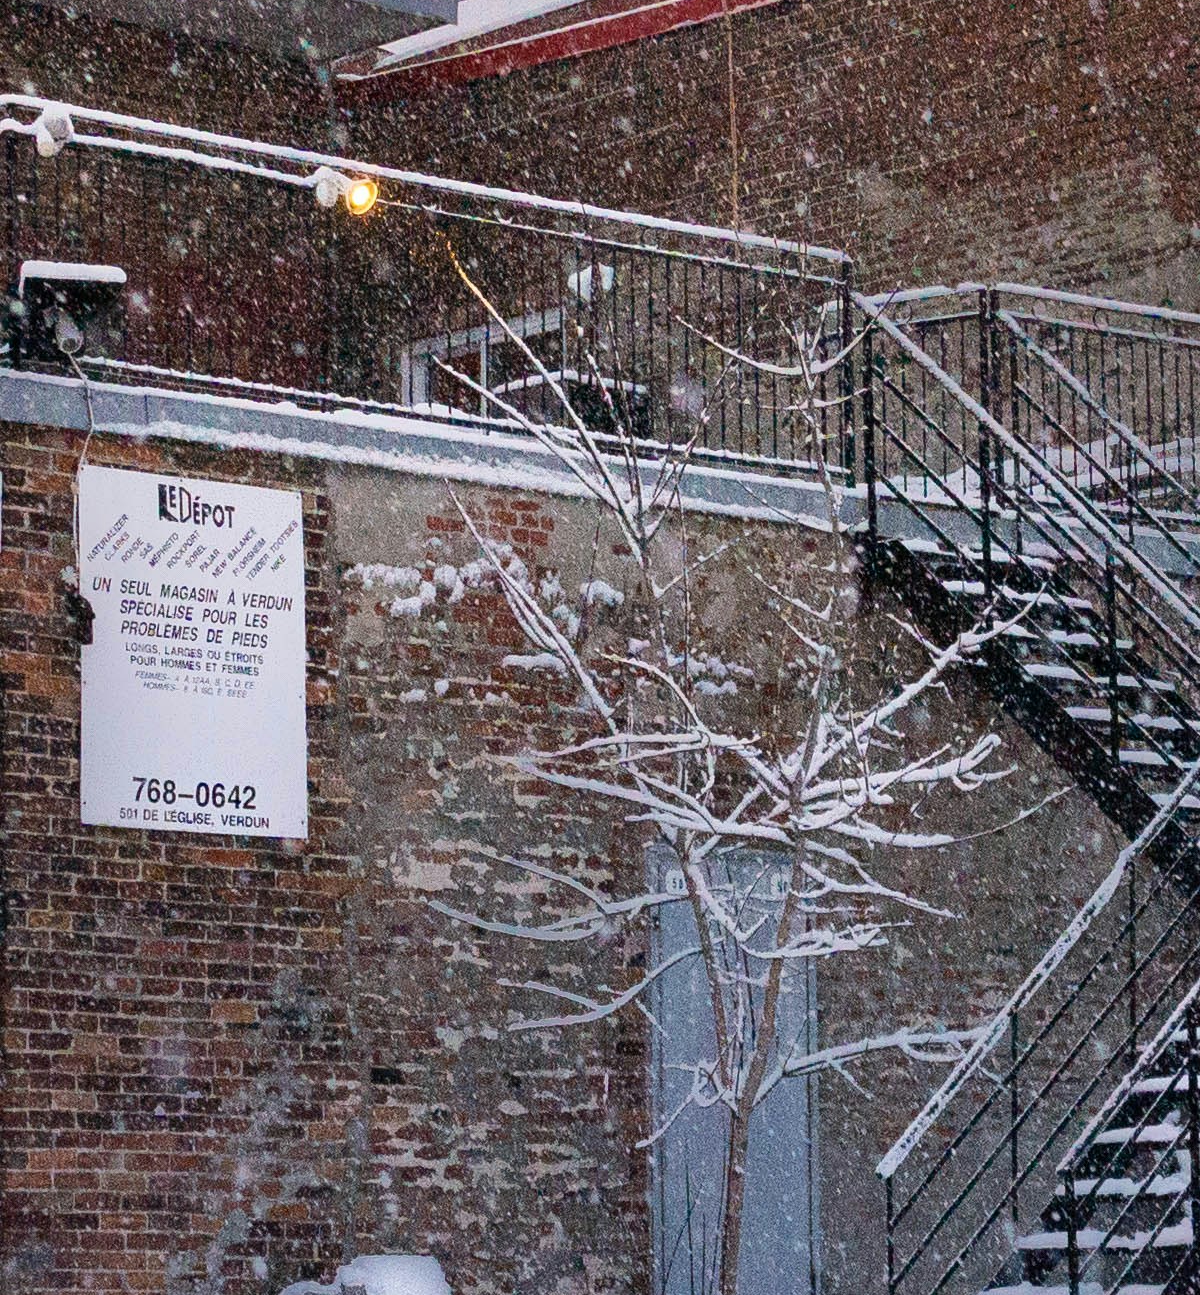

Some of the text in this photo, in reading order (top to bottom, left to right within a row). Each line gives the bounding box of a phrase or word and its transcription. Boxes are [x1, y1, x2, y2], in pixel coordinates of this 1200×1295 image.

[179, 487, 235, 528] DÉPOT
[86, 513, 129, 563] NATURALIZER
[166, 529, 200, 569] ROCKPORT
[185, 544, 208, 569] SOREL
[199, 548, 220, 573] PAJAR
[212, 526, 257, 579] NEW BALANCE
[245, 553, 270, 581] TENDER
[92, 576, 112, 593] UN
[119, 578, 152, 597] SEUL
[160, 583, 219, 604] MAGASIN
[242, 593, 293, 612] VERDUN
[202, 608, 237, 626] POUR
[245, 613, 269, 630] LES
[206, 628, 224, 644] DE
[231, 631, 269, 649] PIEDS
[130, 655, 260, 678] POUR HOMMES ET FEMMES
[207, 650, 221, 660] OU
[132, 776, 257, 811] 768-0642
[119, 807, 138, 820] 501
[143, 809, 159, 822] DE
[221, 813, 270, 829] VERDUN
